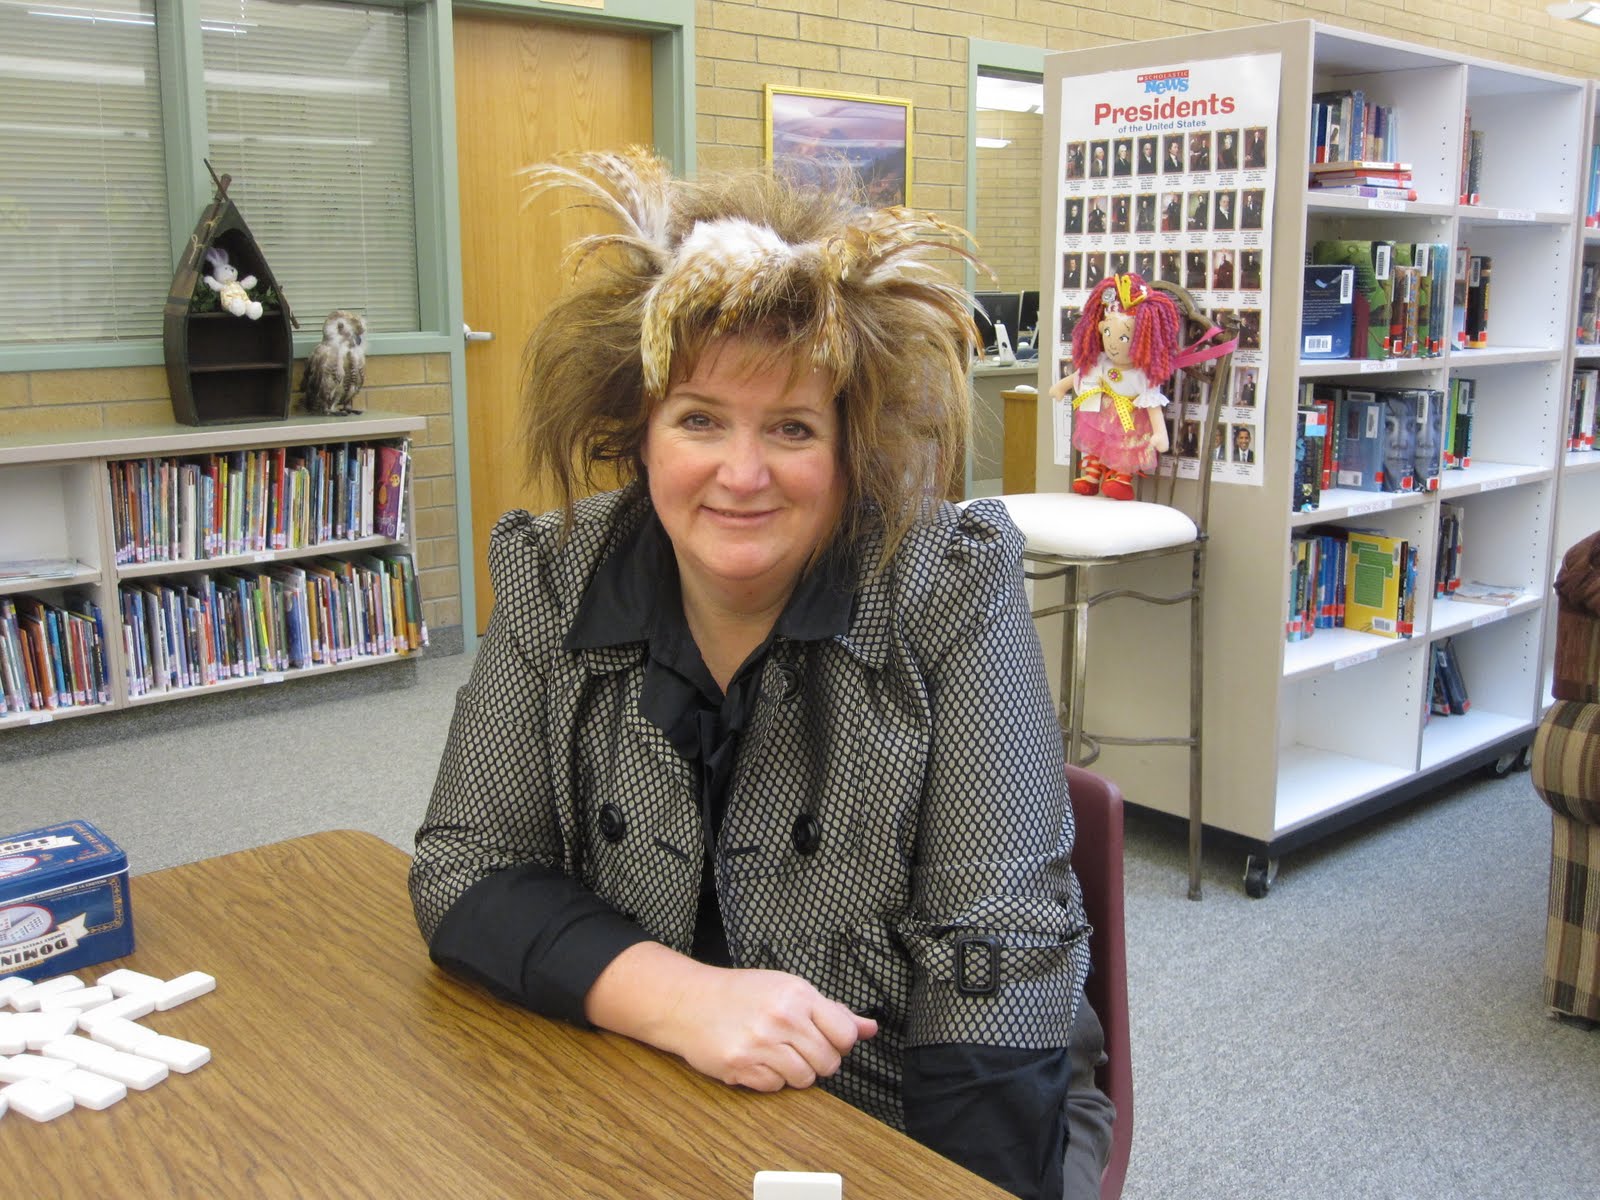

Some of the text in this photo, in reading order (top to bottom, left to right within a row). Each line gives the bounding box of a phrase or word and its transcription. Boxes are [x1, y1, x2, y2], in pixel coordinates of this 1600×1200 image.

[1144, 71, 1188, 80] SCHOLASTIC
[1094, 93, 1235, 125] Presidents
[1118, 119, 1207, 134] of the United States
